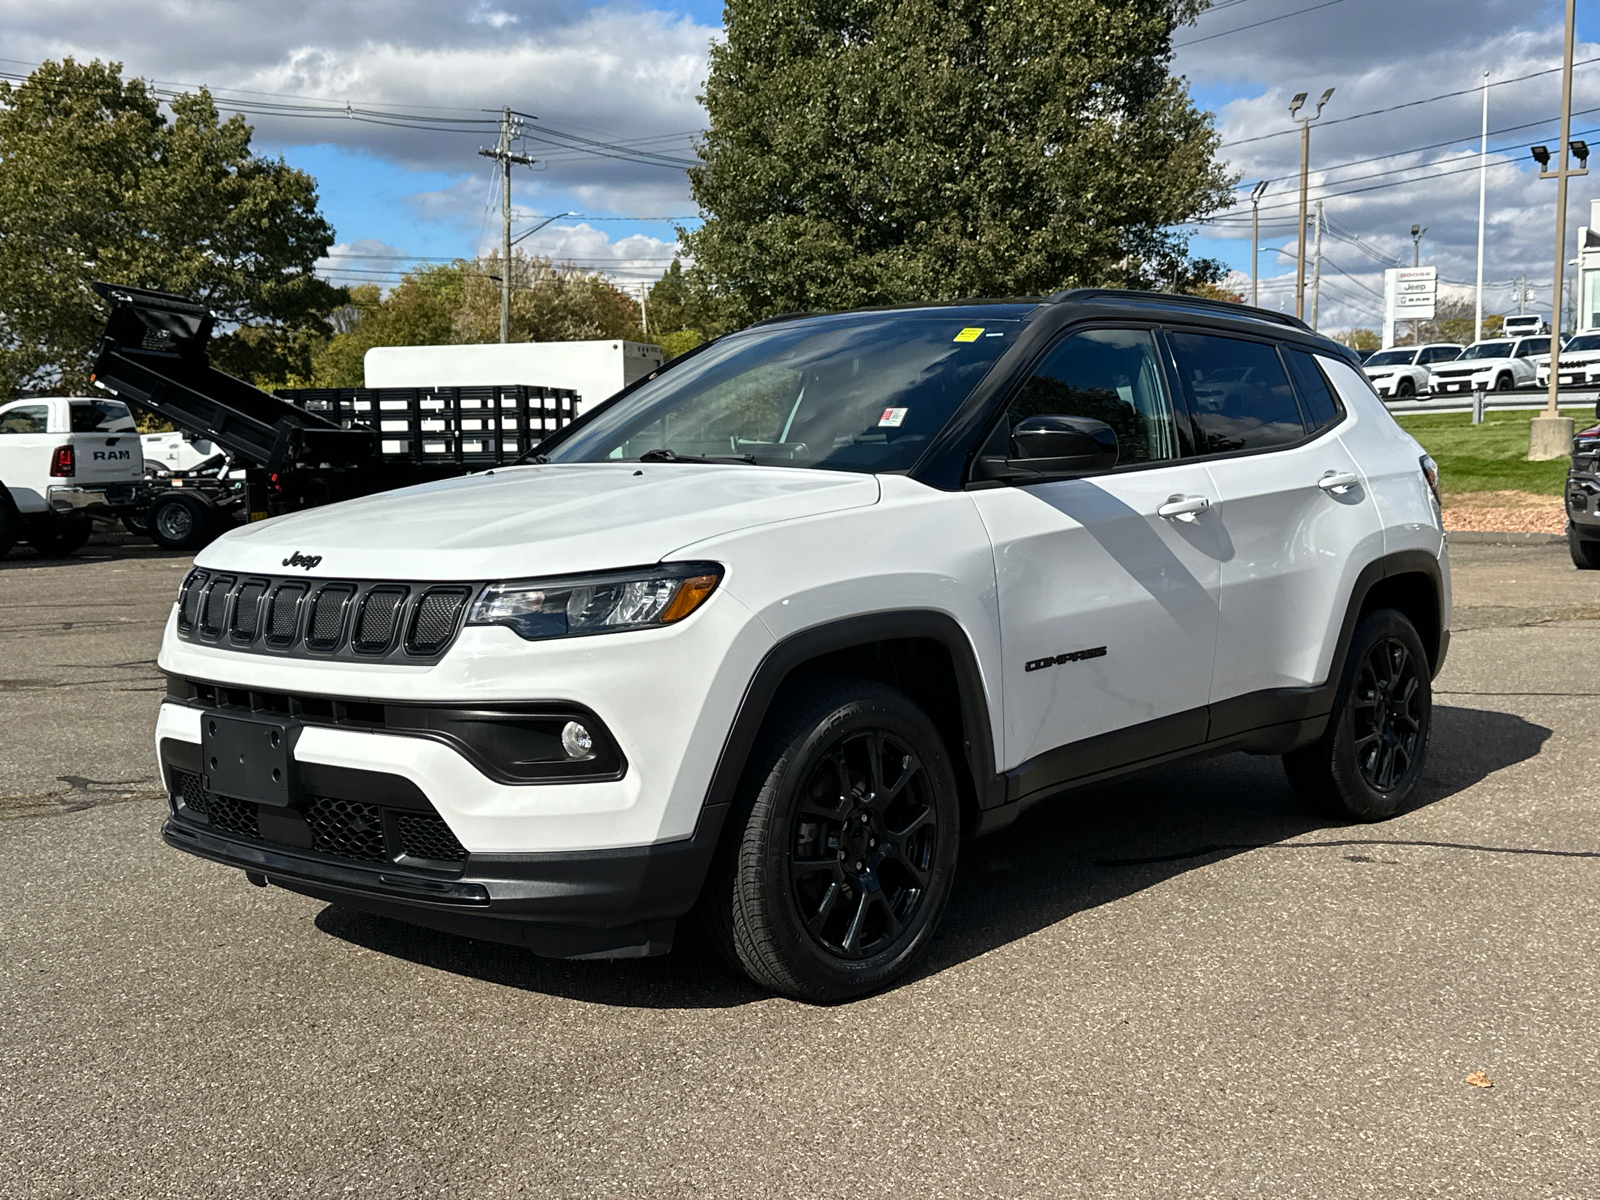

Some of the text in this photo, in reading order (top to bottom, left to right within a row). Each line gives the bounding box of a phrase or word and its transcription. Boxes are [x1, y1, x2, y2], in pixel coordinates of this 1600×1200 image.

[1404, 283, 1426, 291] Jeep
[93, 450, 130, 460] RAM
[282, 550, 323, 571] Jeep
[1025, 645, 1107, 672] COMPASS
